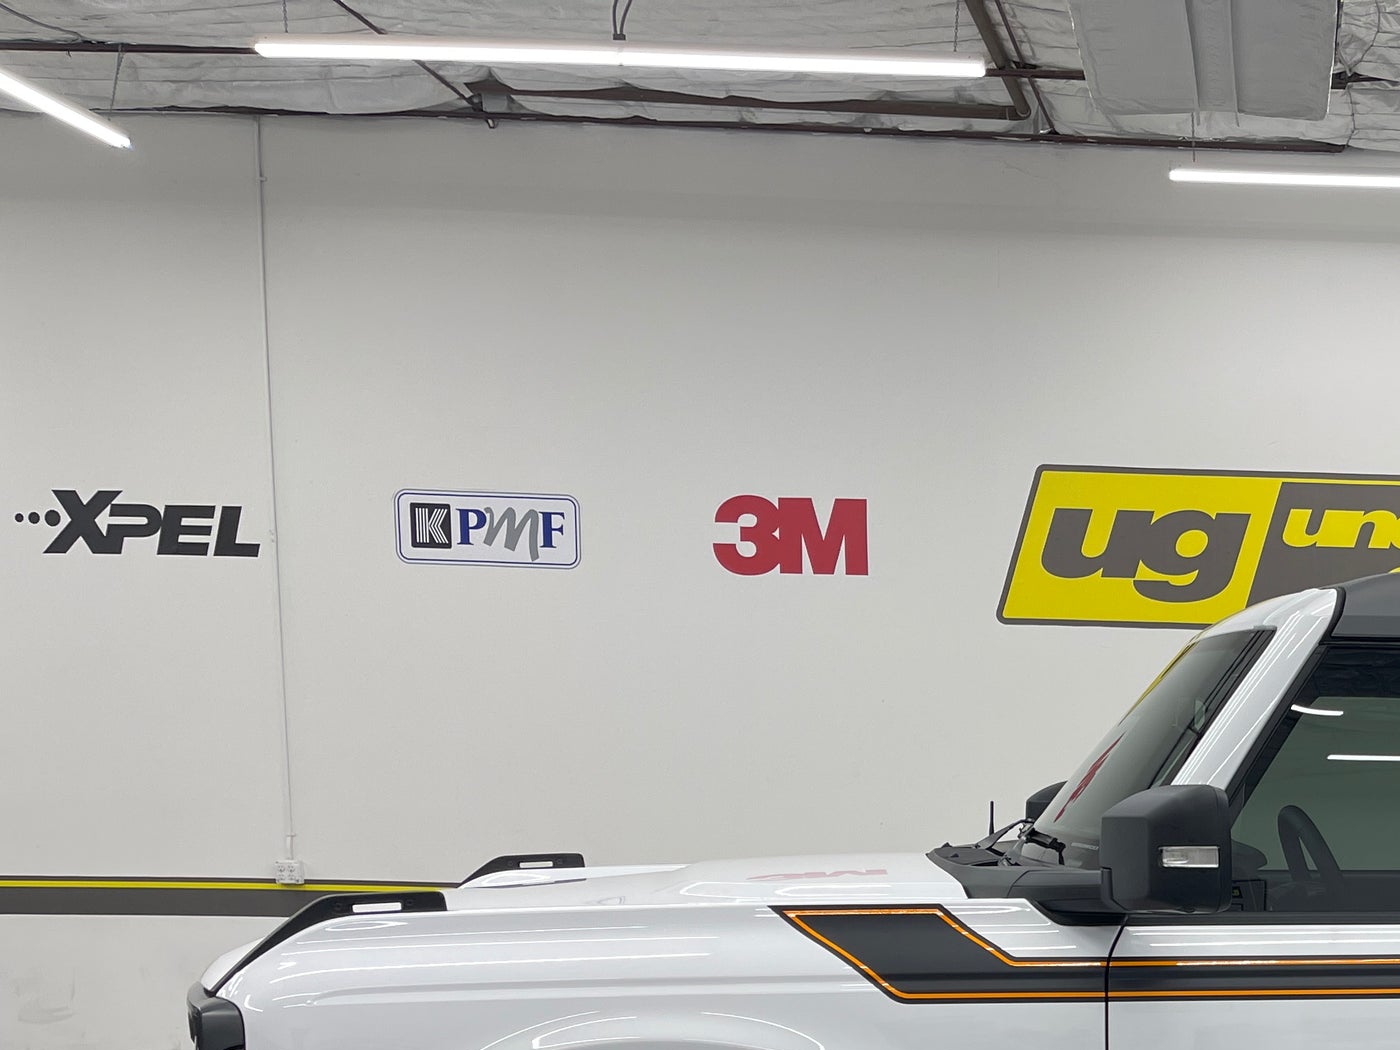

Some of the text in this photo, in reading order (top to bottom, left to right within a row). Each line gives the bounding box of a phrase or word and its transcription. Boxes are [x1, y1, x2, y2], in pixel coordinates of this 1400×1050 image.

[42, 489, 260, 557] XPEL
[713, 494, 869, 576] 3M
[1040, 506, 1252, 603] ug
